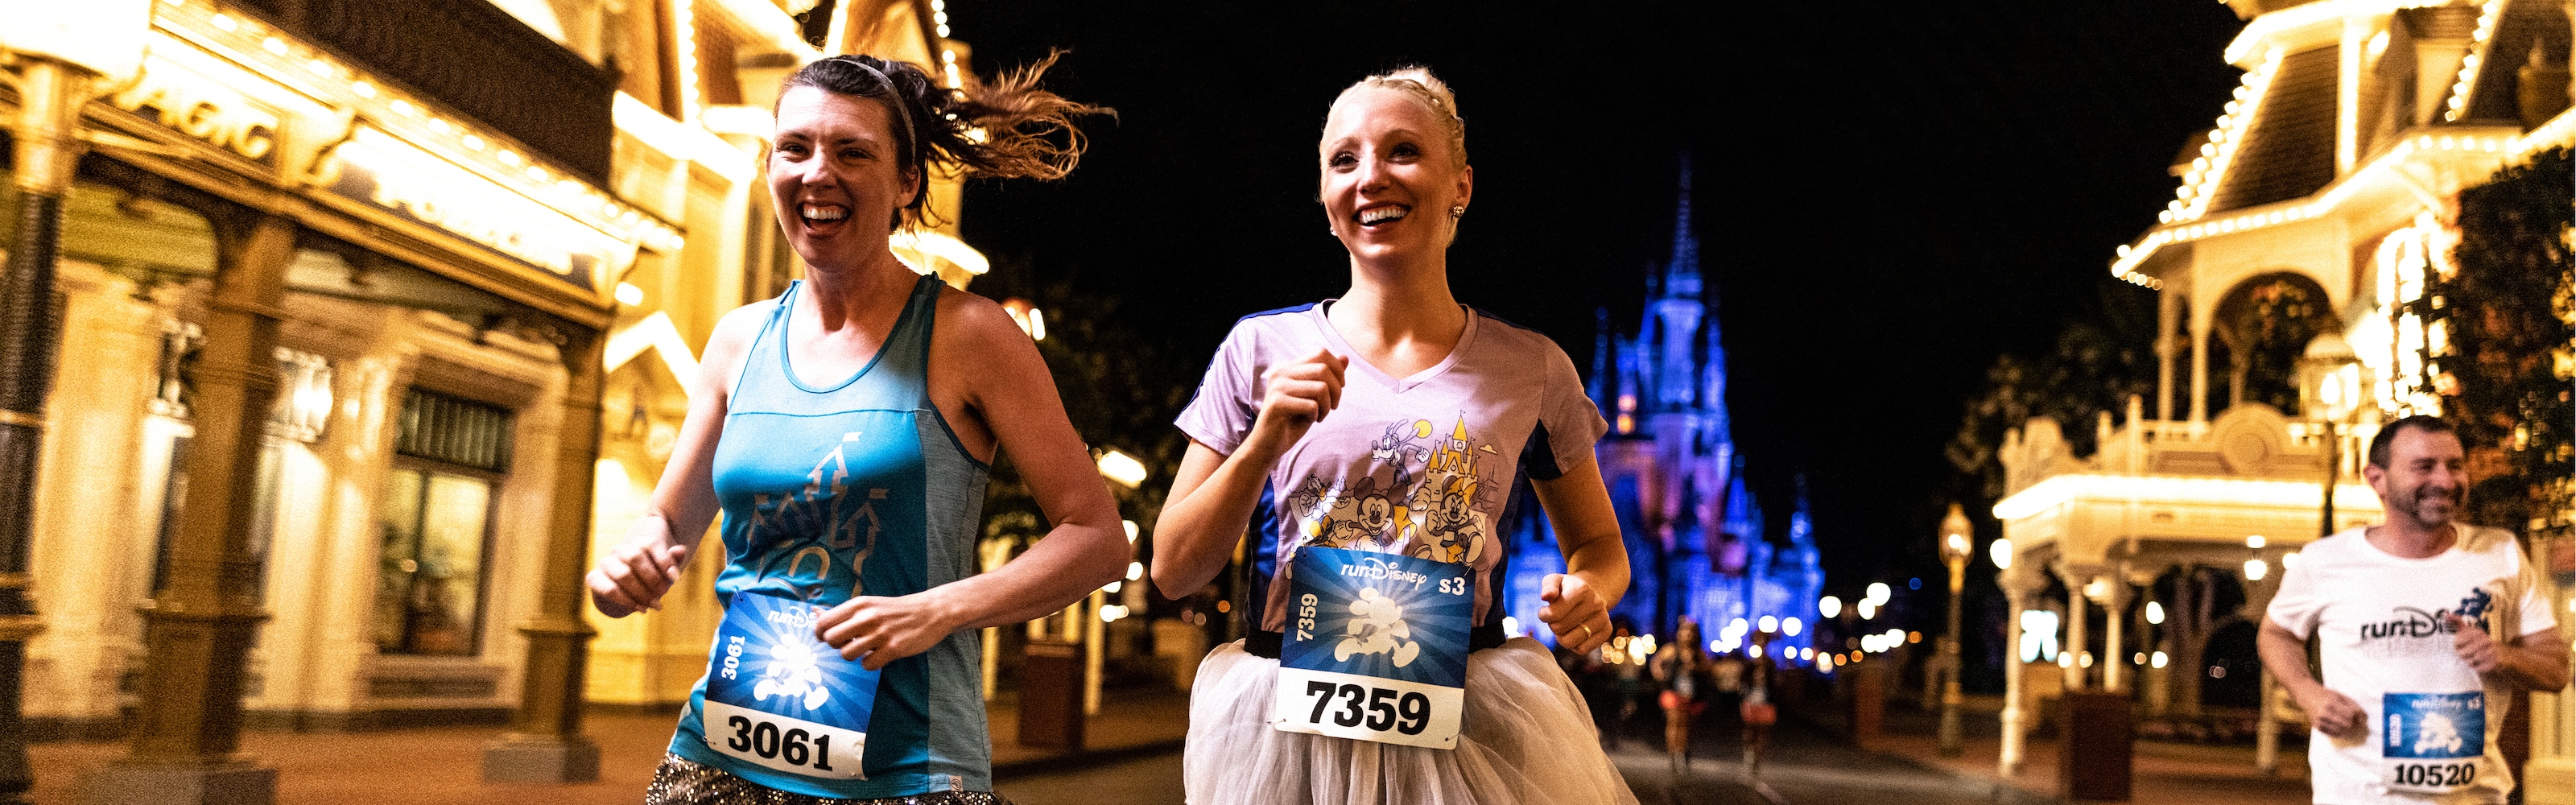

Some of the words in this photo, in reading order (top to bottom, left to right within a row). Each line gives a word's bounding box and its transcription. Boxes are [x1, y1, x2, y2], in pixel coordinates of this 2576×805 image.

[1296, 593, 1319, 642] 7359
[720, 636, 745, 680] 3061
[1307, 680, 1430, 736] 7359
[728, 716, 833, 772] 3061
[2395, 762, 2475, 786] 10520
